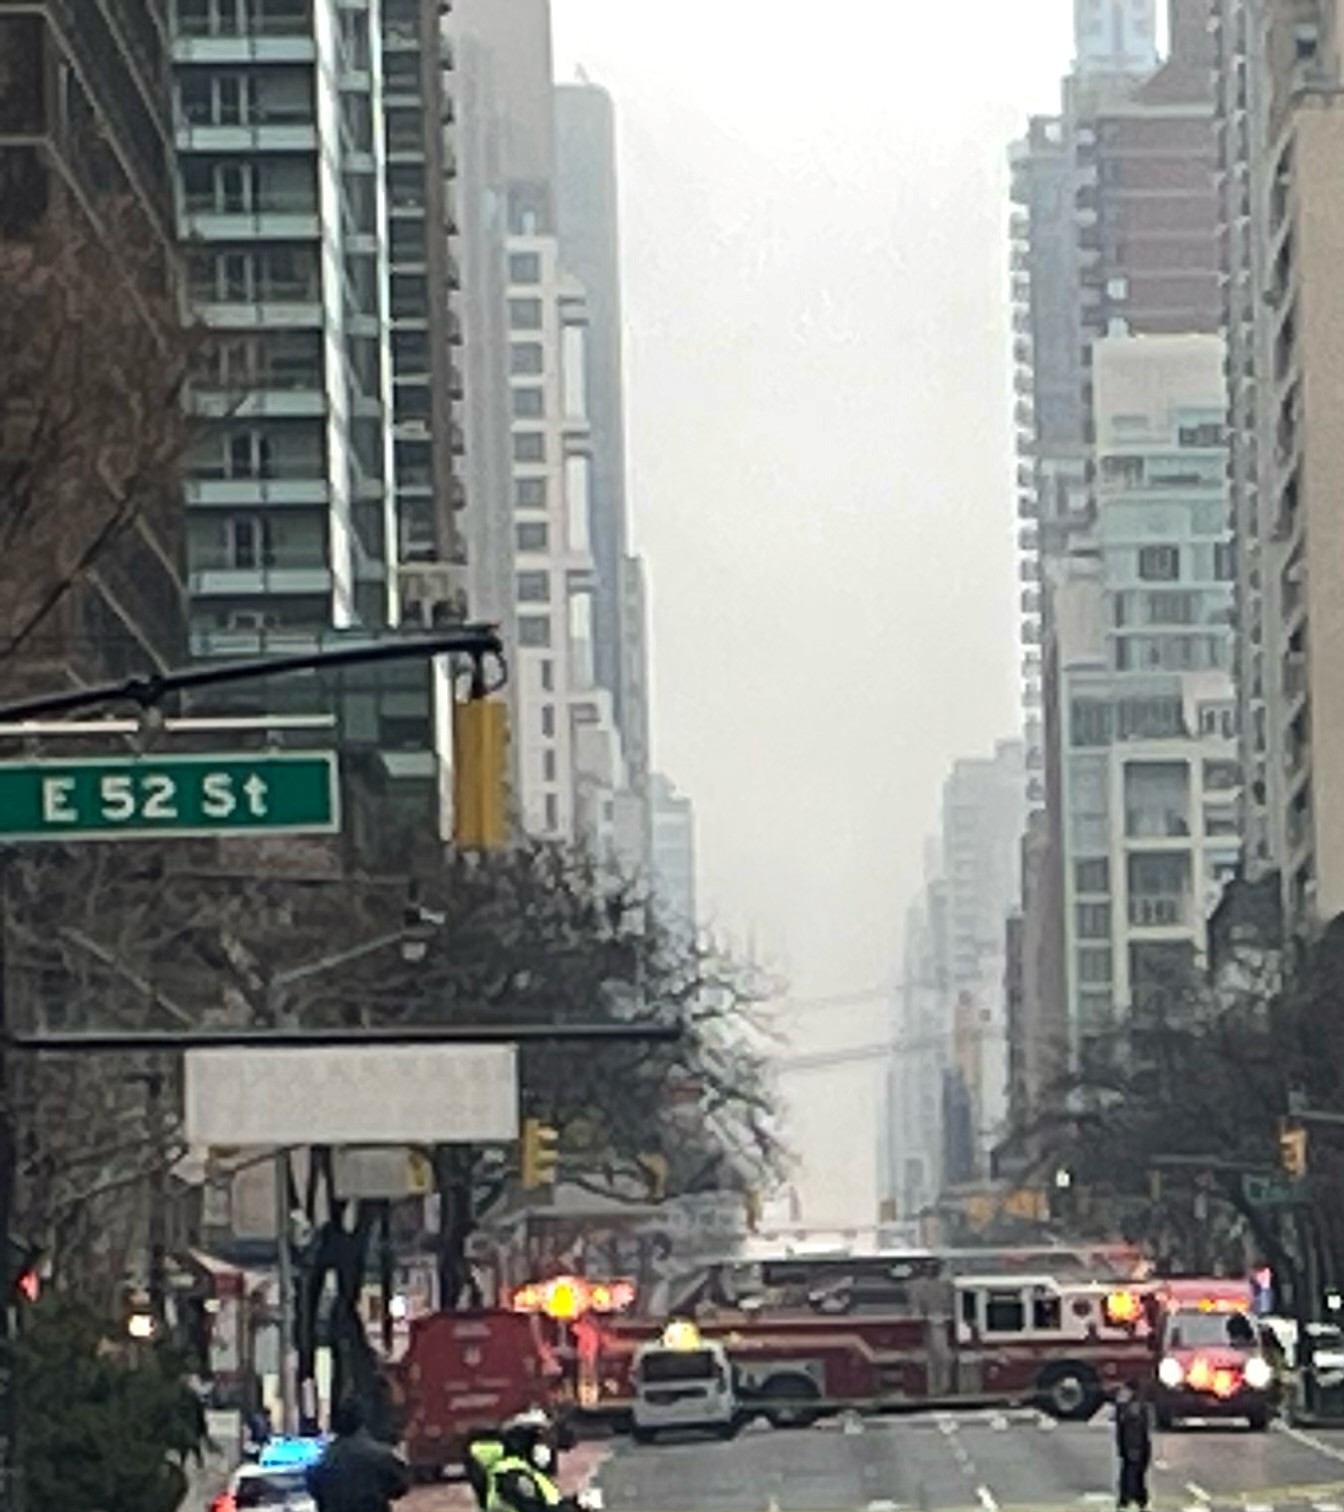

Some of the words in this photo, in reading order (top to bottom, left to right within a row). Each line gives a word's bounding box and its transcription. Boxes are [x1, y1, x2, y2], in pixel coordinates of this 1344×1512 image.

[43, 775, 79, 822] E
[101, 775, 178, 820] 52
[202, 772, 268, 817] St
